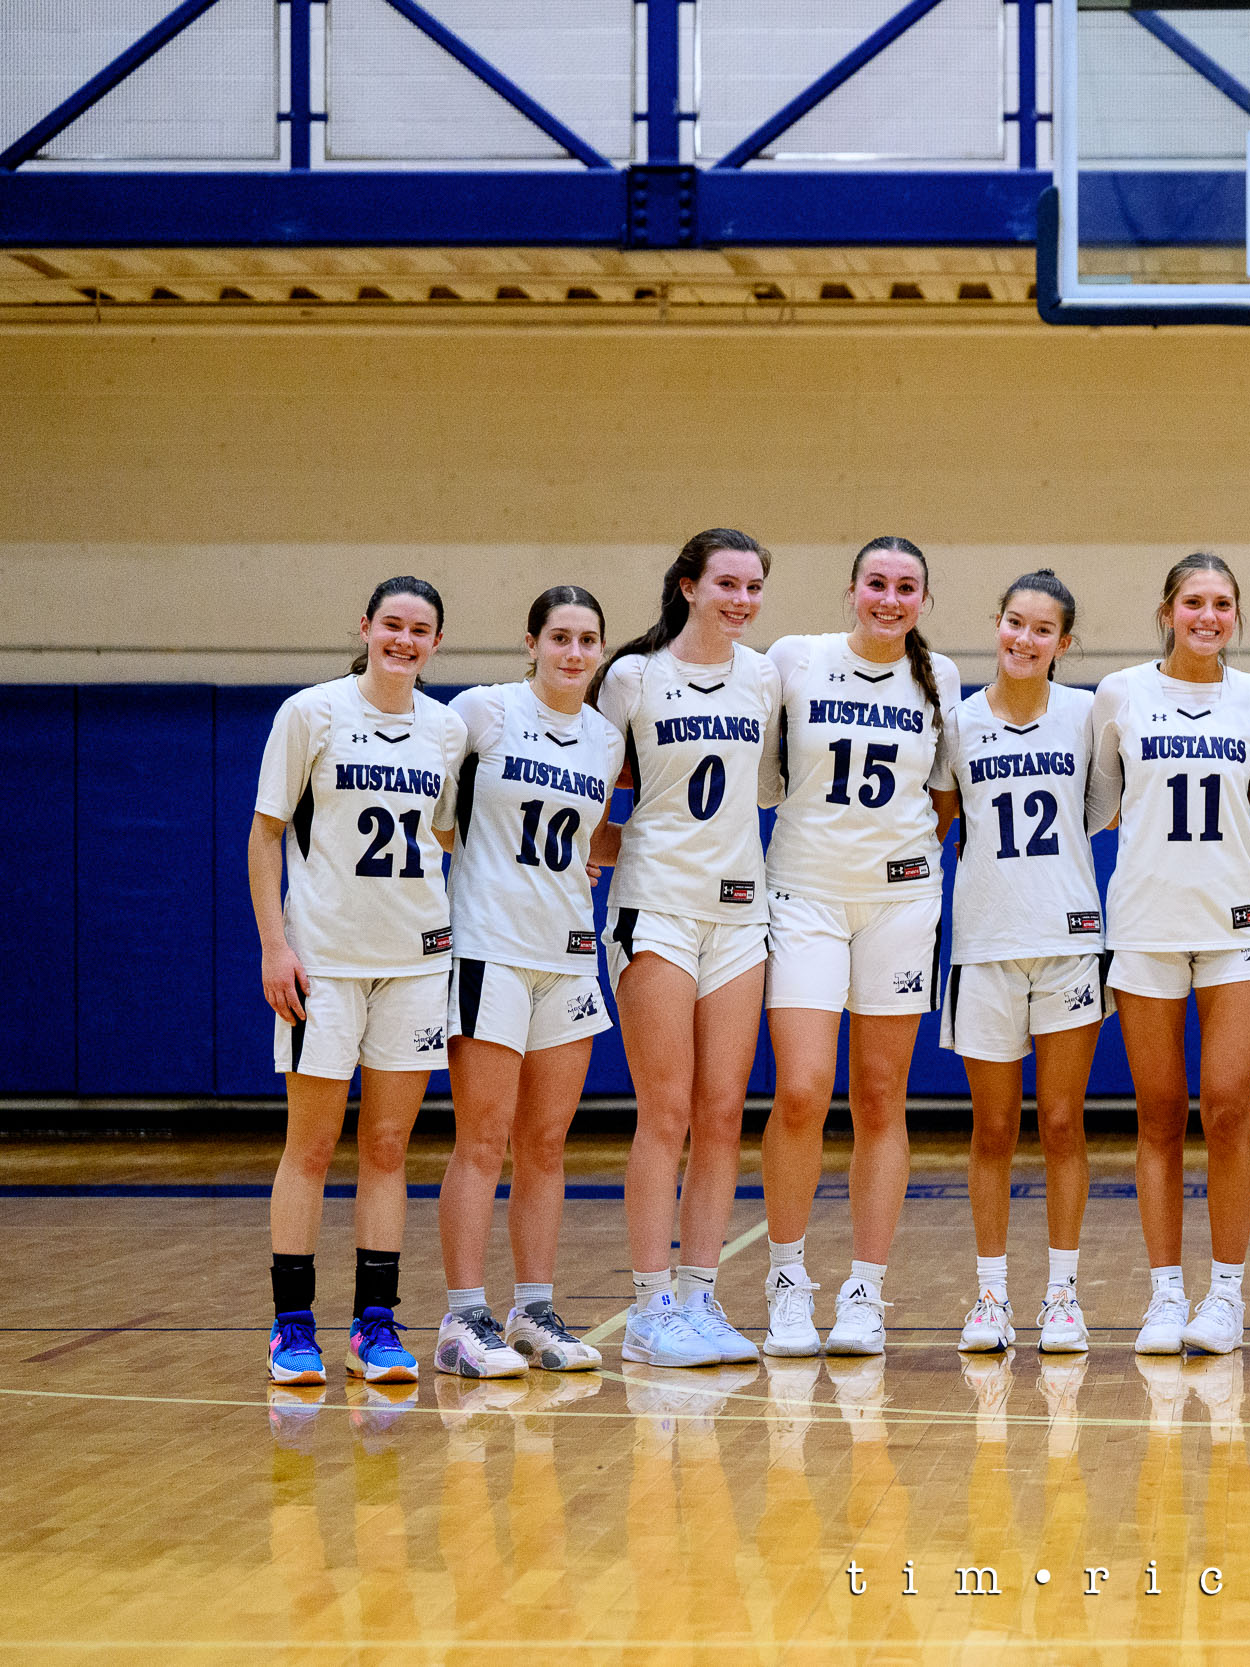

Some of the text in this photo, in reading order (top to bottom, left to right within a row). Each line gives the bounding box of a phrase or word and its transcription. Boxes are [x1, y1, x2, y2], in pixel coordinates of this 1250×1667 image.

[655, 715, 759, 745] MUSTANGS
[809, 700, 923, 733] MUSTANGS
[826, 739, 898, 808] 15
[969, 752, 1075, 784] MUSTANGS
[1141, 736, 1246, 763] MUSTANGS
[336, 764, 440, 799] MUSTANGS
[502, 756, 604, 804] MUSTANGS
[688, 755, 725, 820] 0
[1167, 774, 1223, 841] 11
[356, 807, 424, 878] 21
[516, 800, 580, 872] 10
[992, 790, 1059, 859] 12
